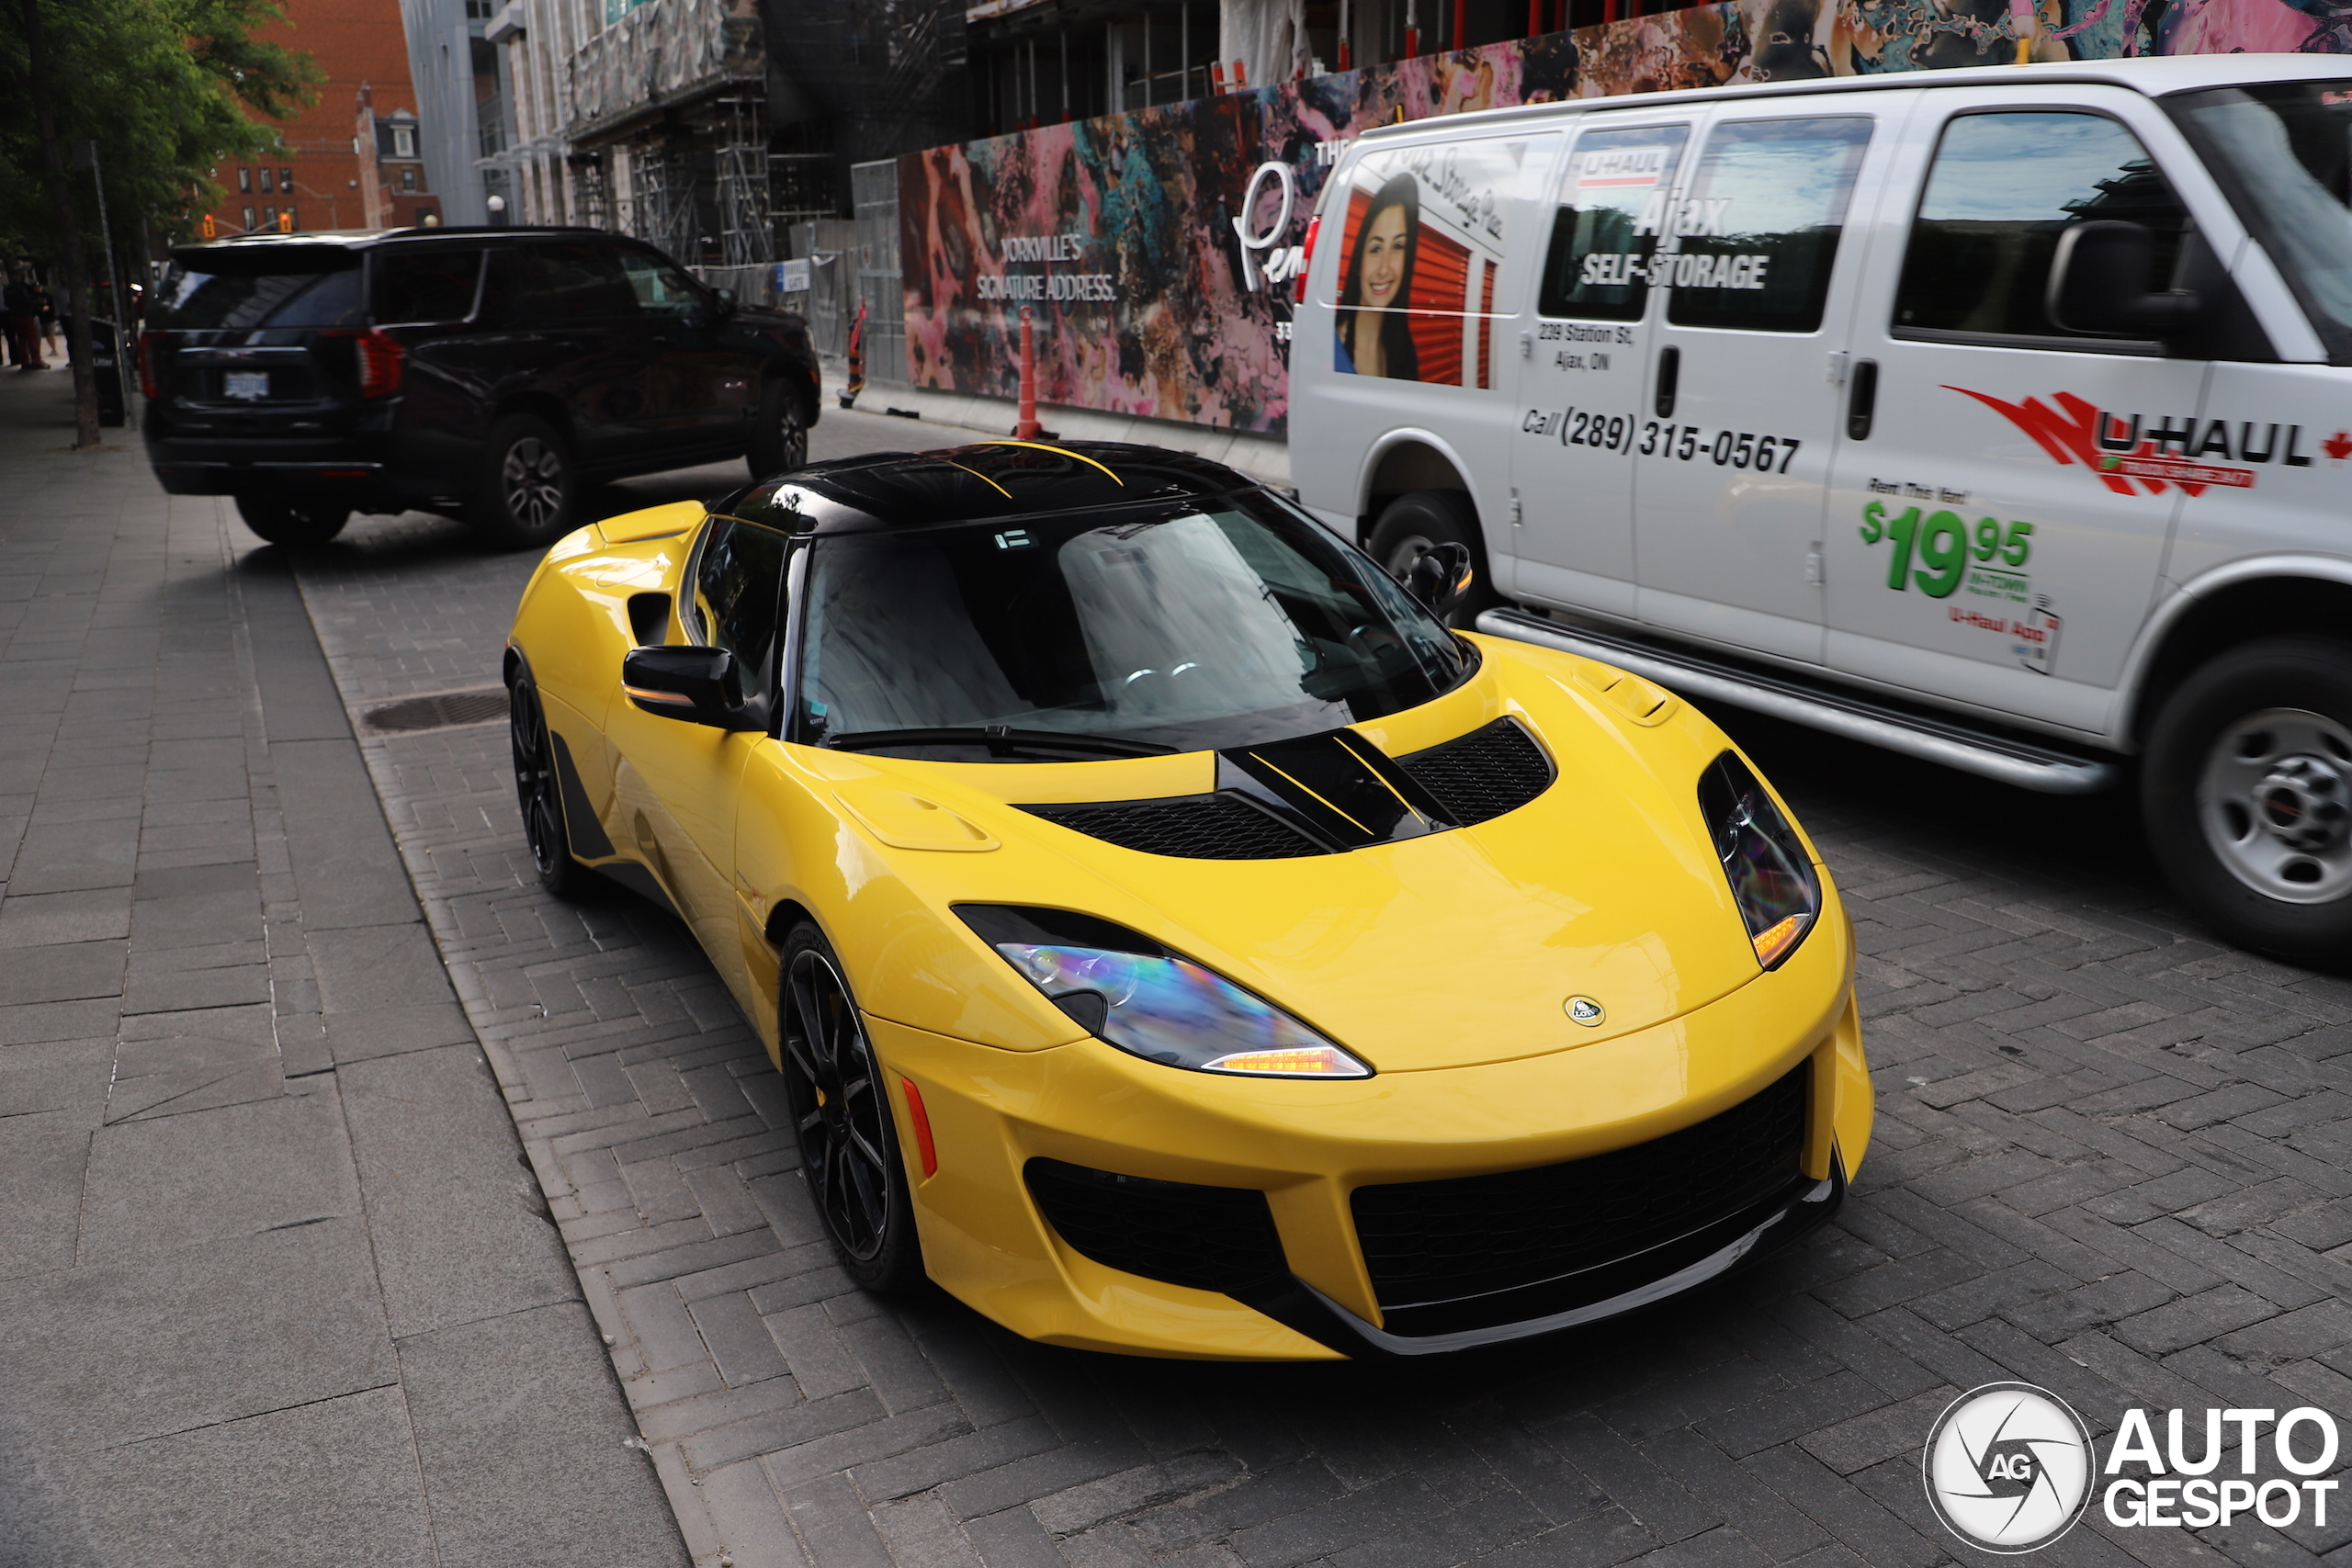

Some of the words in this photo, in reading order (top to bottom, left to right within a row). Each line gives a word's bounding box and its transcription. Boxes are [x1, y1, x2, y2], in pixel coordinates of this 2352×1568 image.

[1632, 187, 1734, 253] Ajax
[1001, 233, 1082, 263] YORKVILLE'S
[1580, 252, 1770, 289] SELF-STORAGE
[977, 275, 1045, 300] SIGNATURE
[1046, 274, 1118, 301] ADDRESS.
[1538, 323, 1561, 341] 239
[1565, 324, 1612, 344] Station
[1554, 351, 1588, 371] Ajax,
[1589, 353, 1611, 371] ON
[1522, 409, 1562, 436] Call
[1561, 406, 1634, 455] (289)
[1640, 421, 1802, 474] 315-0567
[2098, 412, 2315, 468] U-HAUL
[1866, 478, 1902, 496] Rent
[1903, 482, 1933, 501] This
[1948, 605, 2009, 634] U-Haul
[2011, 621, 2048, 645] App
